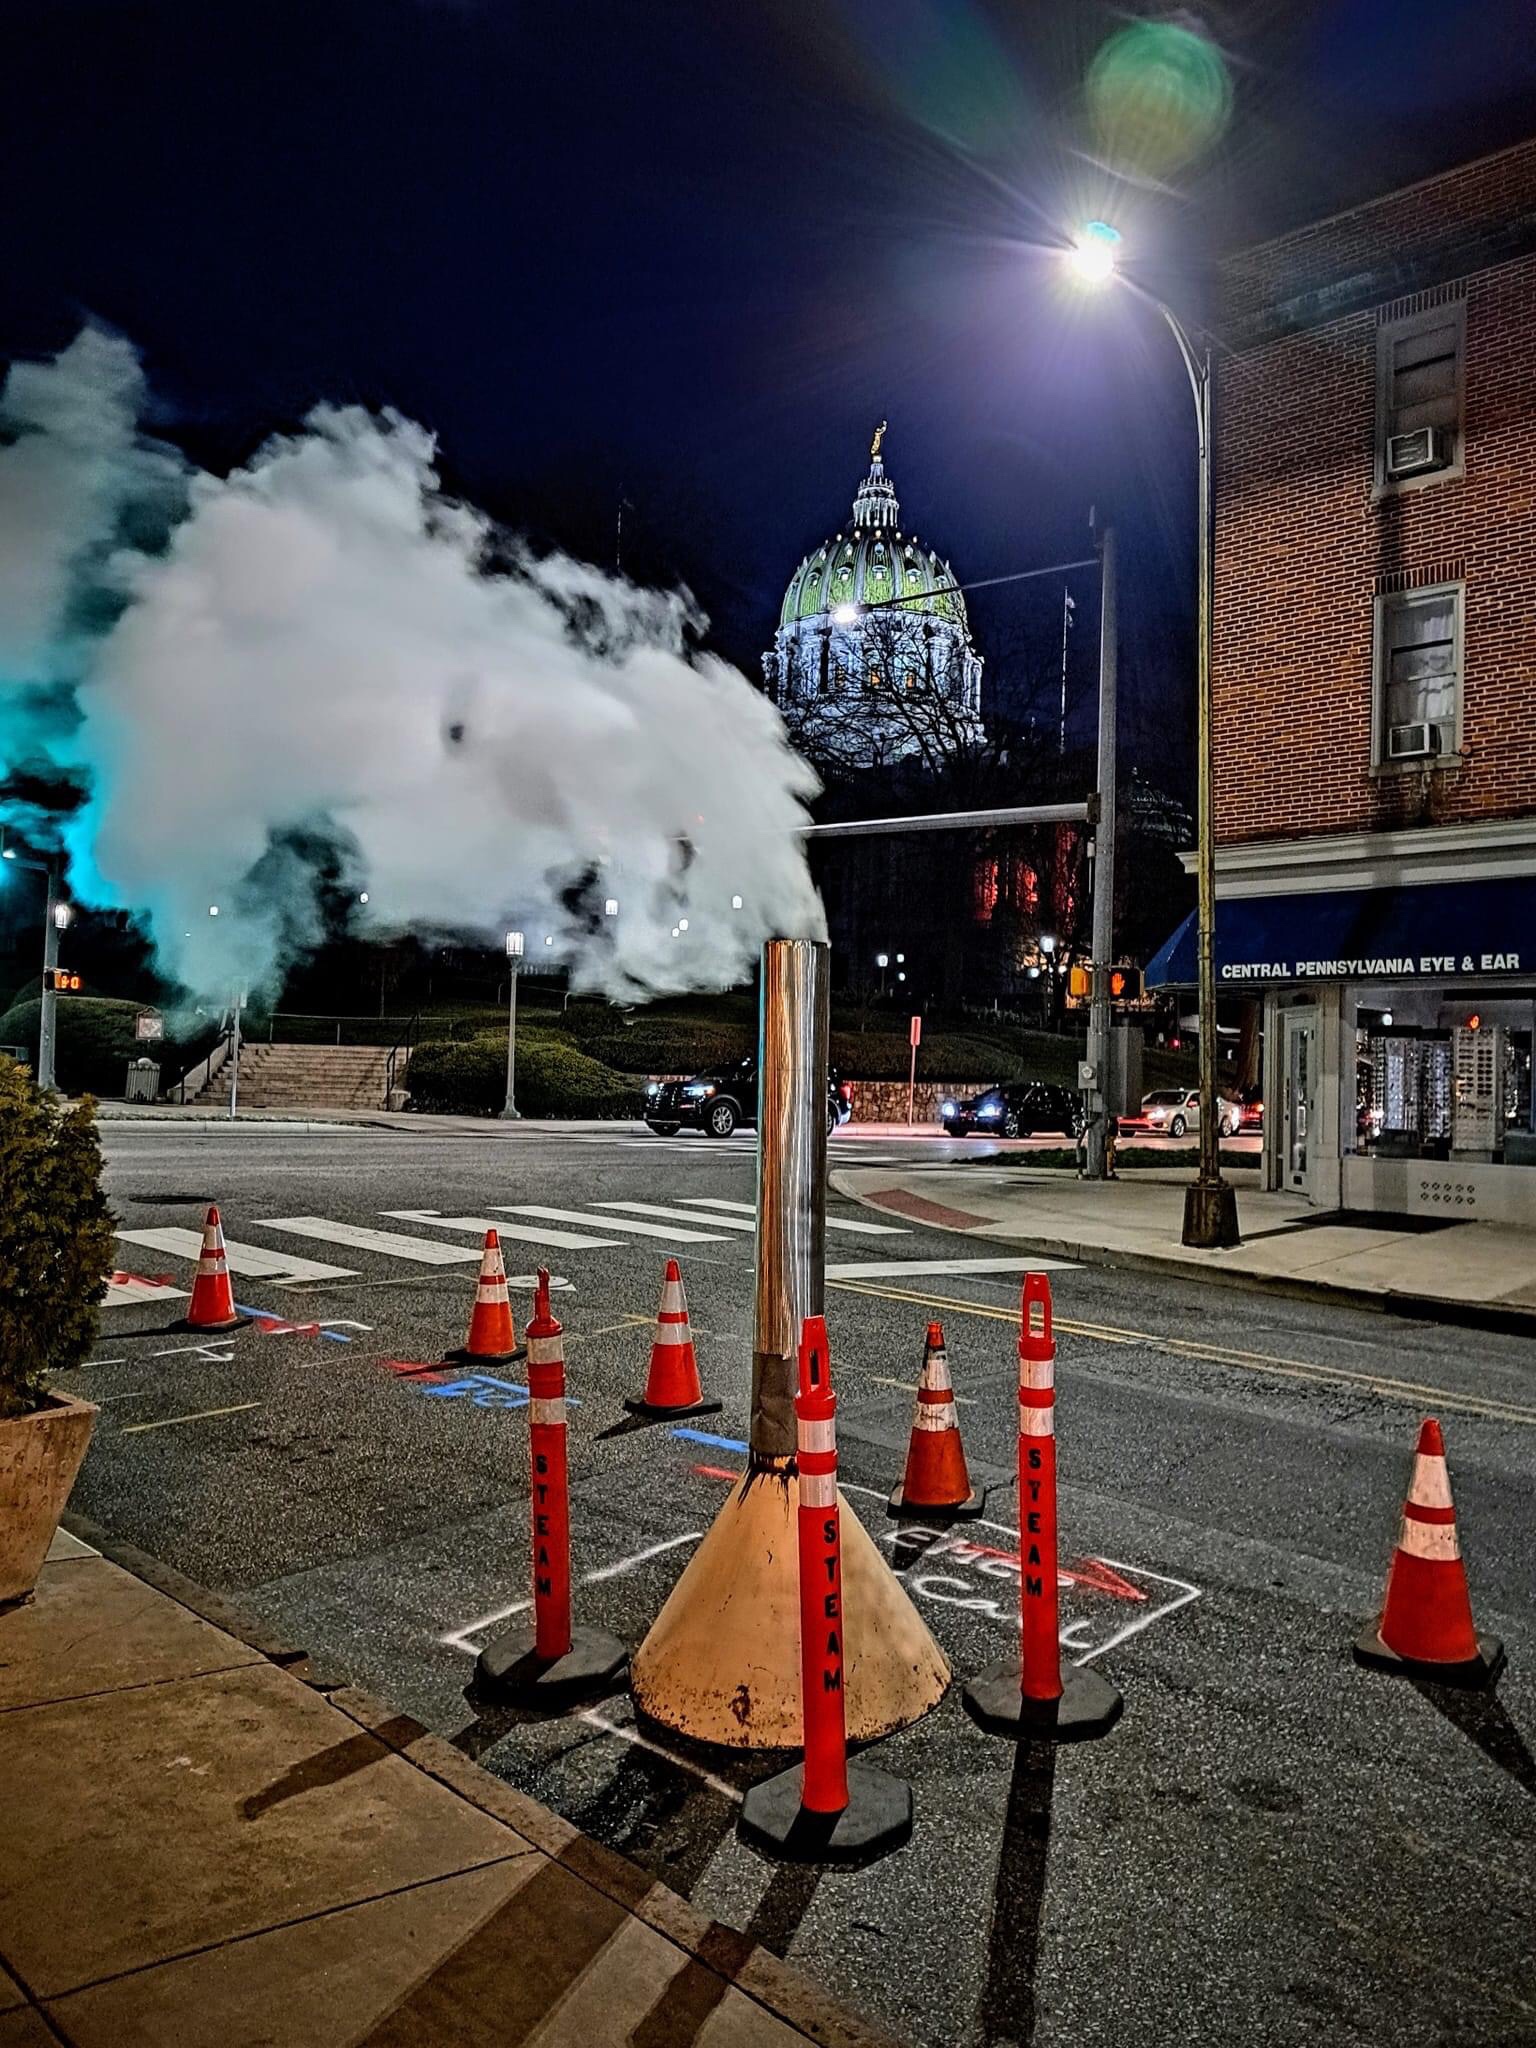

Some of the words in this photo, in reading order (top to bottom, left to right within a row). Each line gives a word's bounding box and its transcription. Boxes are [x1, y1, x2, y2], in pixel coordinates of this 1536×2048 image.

[1221, 963, 1291, 979] CENTRAL
[1295, 957, 1415, 976] PENNSYLVANIA
[1420, 956, 1455, 973] EYE
[1461, 955, 1474, 971] &
[1481, 953, 1520, 970] EAR
[536, 1455, 551, 1596] STEAM
[1026, 1449, 1042, 1597] STEAM
[823, 1519, 841, 1692] STEAM
